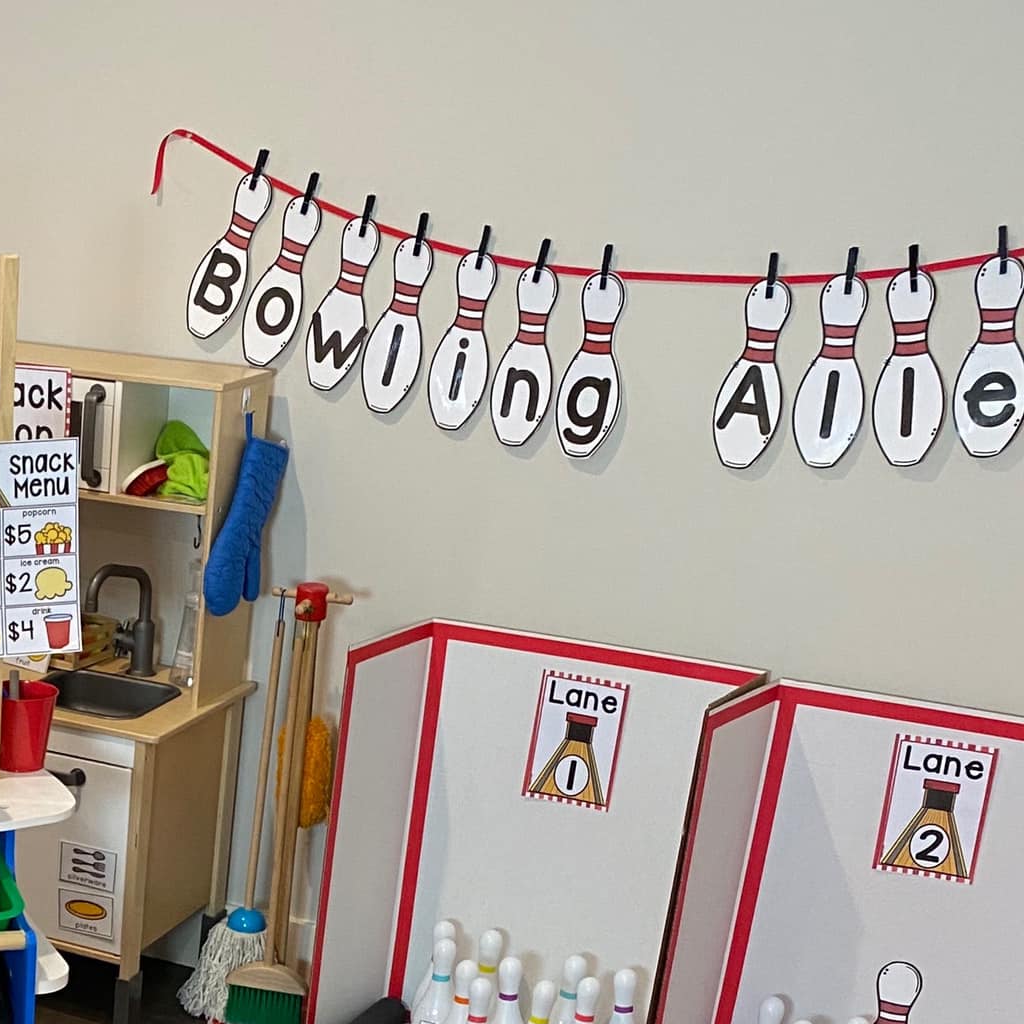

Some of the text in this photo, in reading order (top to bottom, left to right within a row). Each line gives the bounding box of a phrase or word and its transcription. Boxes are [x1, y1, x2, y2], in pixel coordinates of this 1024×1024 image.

[14, 476, 70, 499] Menu
[22, 508, 57, 518] popcorn
[4, 524, 32, 546] $5
[20, 558, 60, 567] ice cream
[5, 572, 33, 594] $2
[32, 607, 52, 615] drink
[8, 620, 34, 642] $4
[549, 680, 618, 713] Lane
[903, 745, 984, 780] Lane
[566, 760, 577, 790] 1
[915, 829, 944, 863] 2
